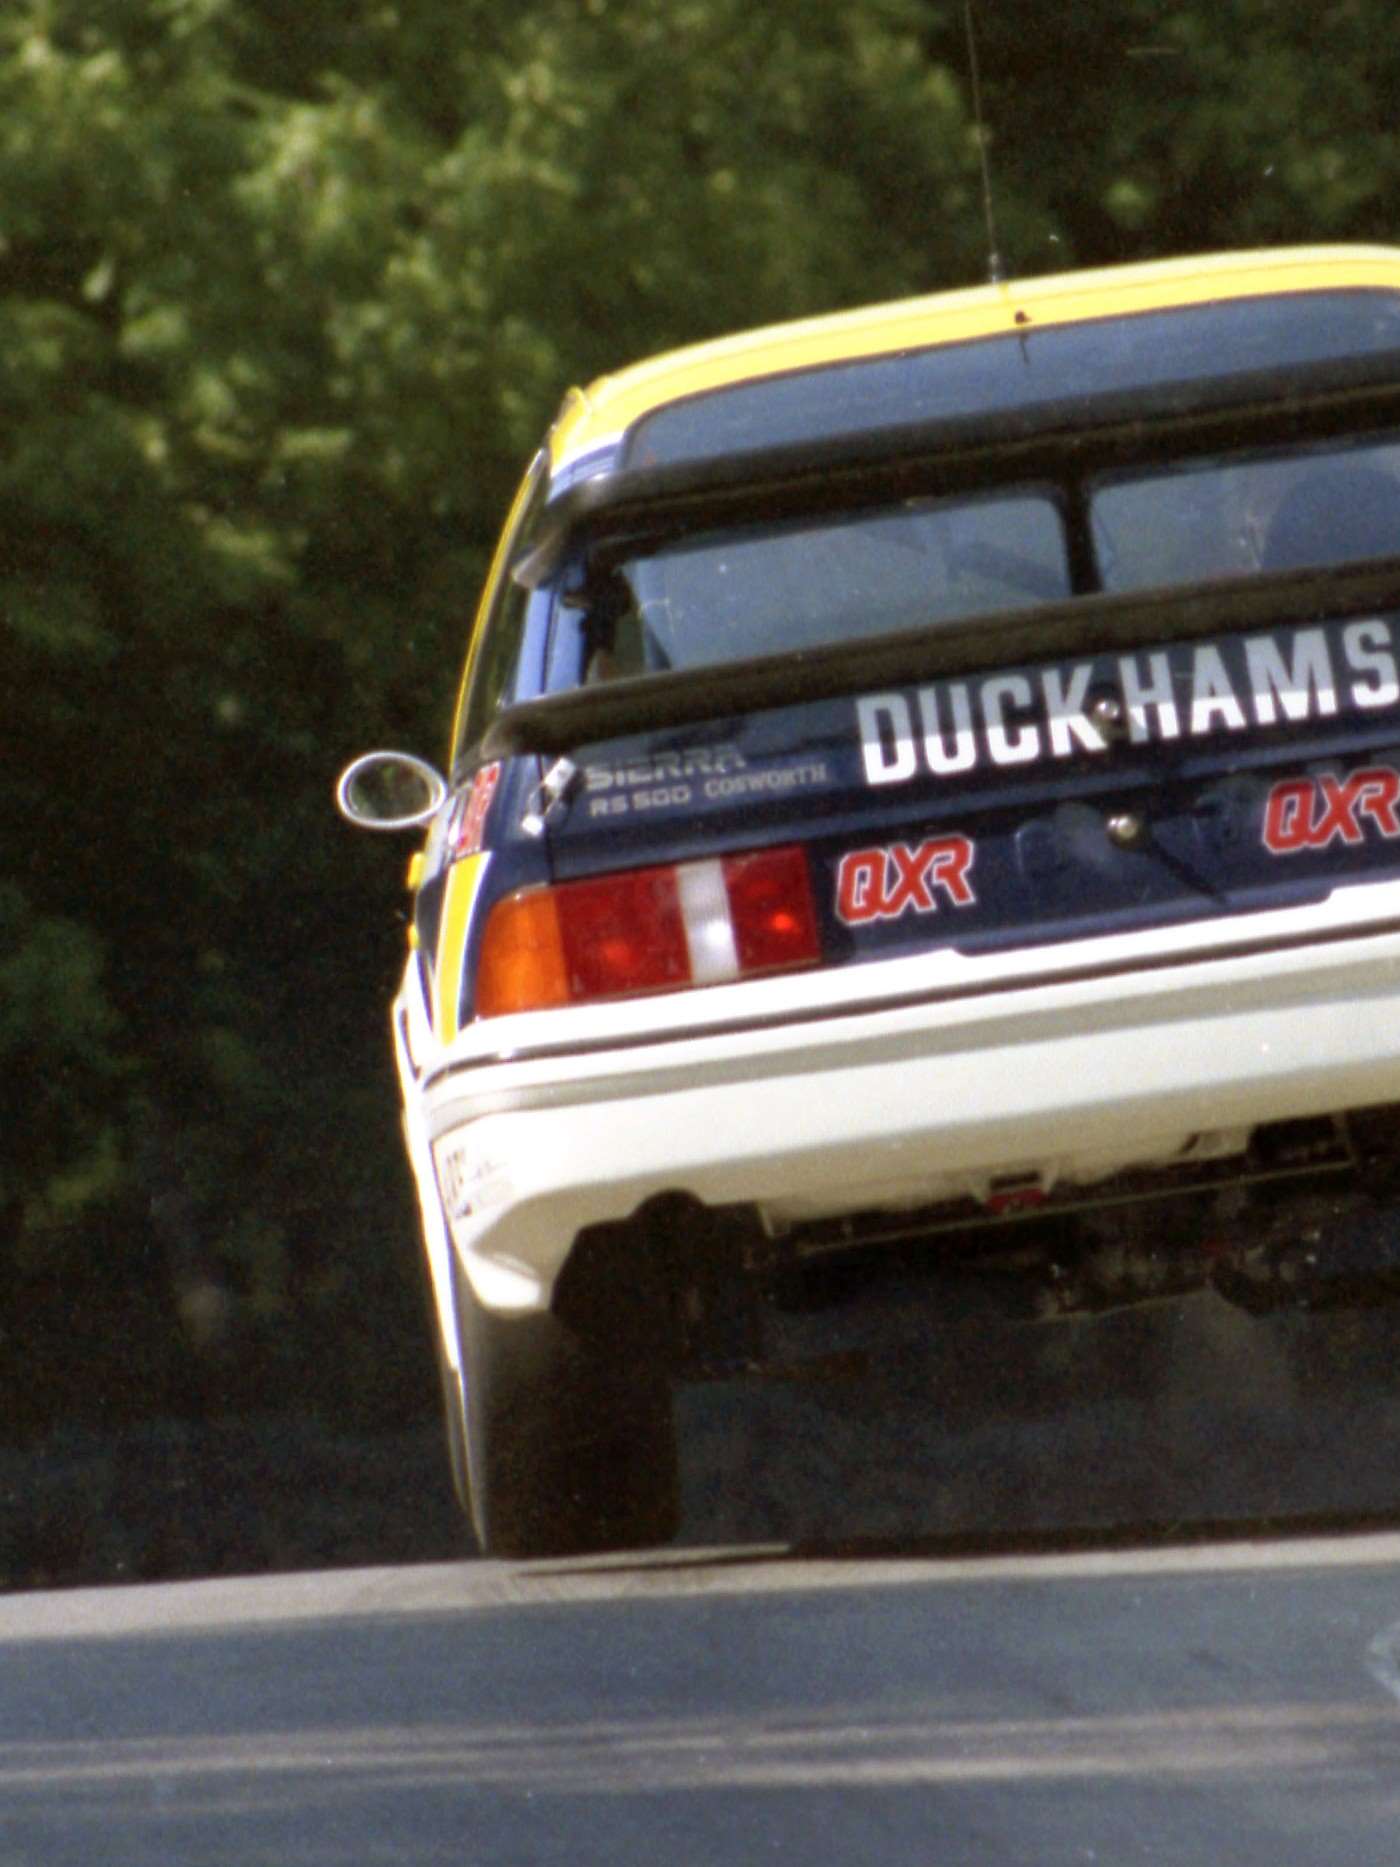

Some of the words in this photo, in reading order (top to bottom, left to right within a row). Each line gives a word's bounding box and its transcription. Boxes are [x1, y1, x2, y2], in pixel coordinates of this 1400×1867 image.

[856, 619, 1400, 786] DUCKHAMS
[704, 764, 829, 798] COSWORTH
[835, 833, 976, 925] QXR
